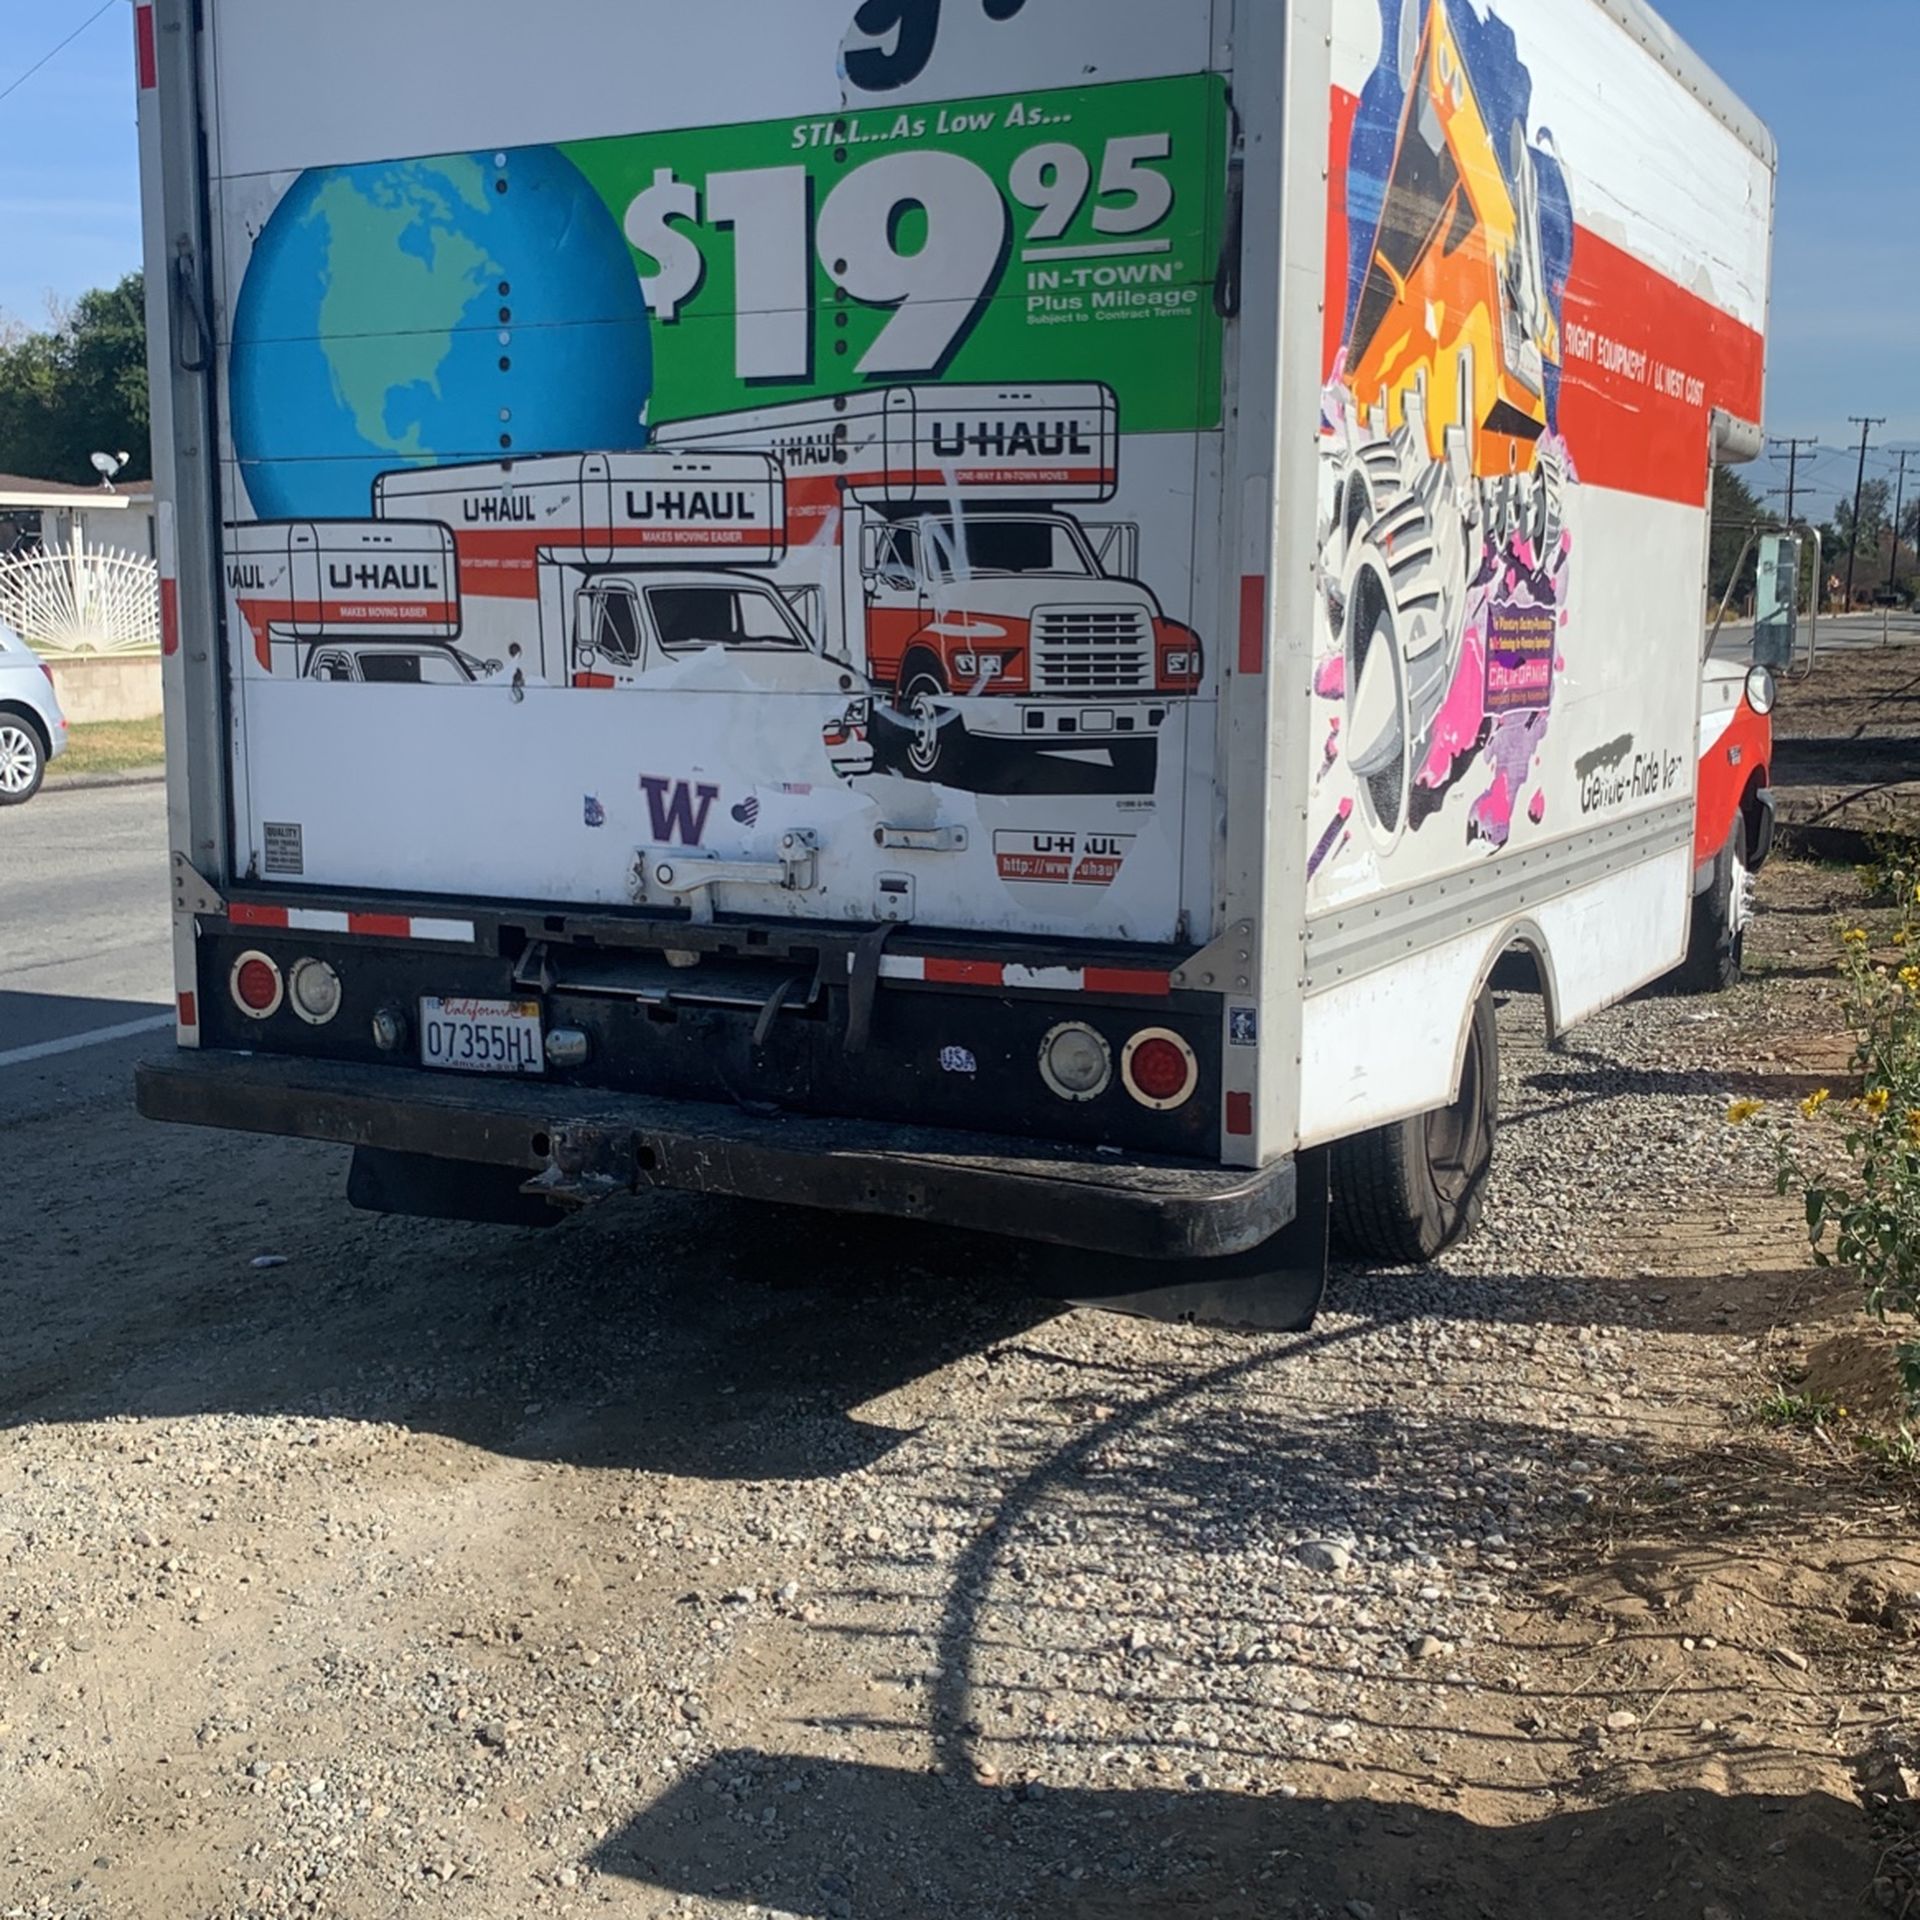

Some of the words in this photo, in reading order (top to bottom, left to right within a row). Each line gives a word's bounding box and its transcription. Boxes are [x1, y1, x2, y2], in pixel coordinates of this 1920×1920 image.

[936, 109, 996, 135] Low
[1004, 102, 1072, 129] As...
[1027, 295, 1083, 312] Plus
[1091, 289, 1198, 308] Mileage
[1026, 312, 1073, 326] Subject
[1076, 312, 1089, 323] to
[1095, 307, 1150, 321] Contract
[1154, 306, 1192, 317] Terms
[932, 420, 1091, 457] U-HAUL
[463, 494, 536, 522] U-HAUL
[626, 490, 755, 520] U-HAUL
[642, 531, 673, 542] MAKES
[674, 531, 709, 543] MOVING
[711, 531, 743, 543] EASIER
[329, 564, 439, 590] U-HAUL
[340, 606, 367, 618] MAKES
[368, 606, 399, 618] MOVING
[640, 775, 720, 847] W
[443, 999, 523, 1022] California
[427, 1021, 538, 1064] 07355H1
